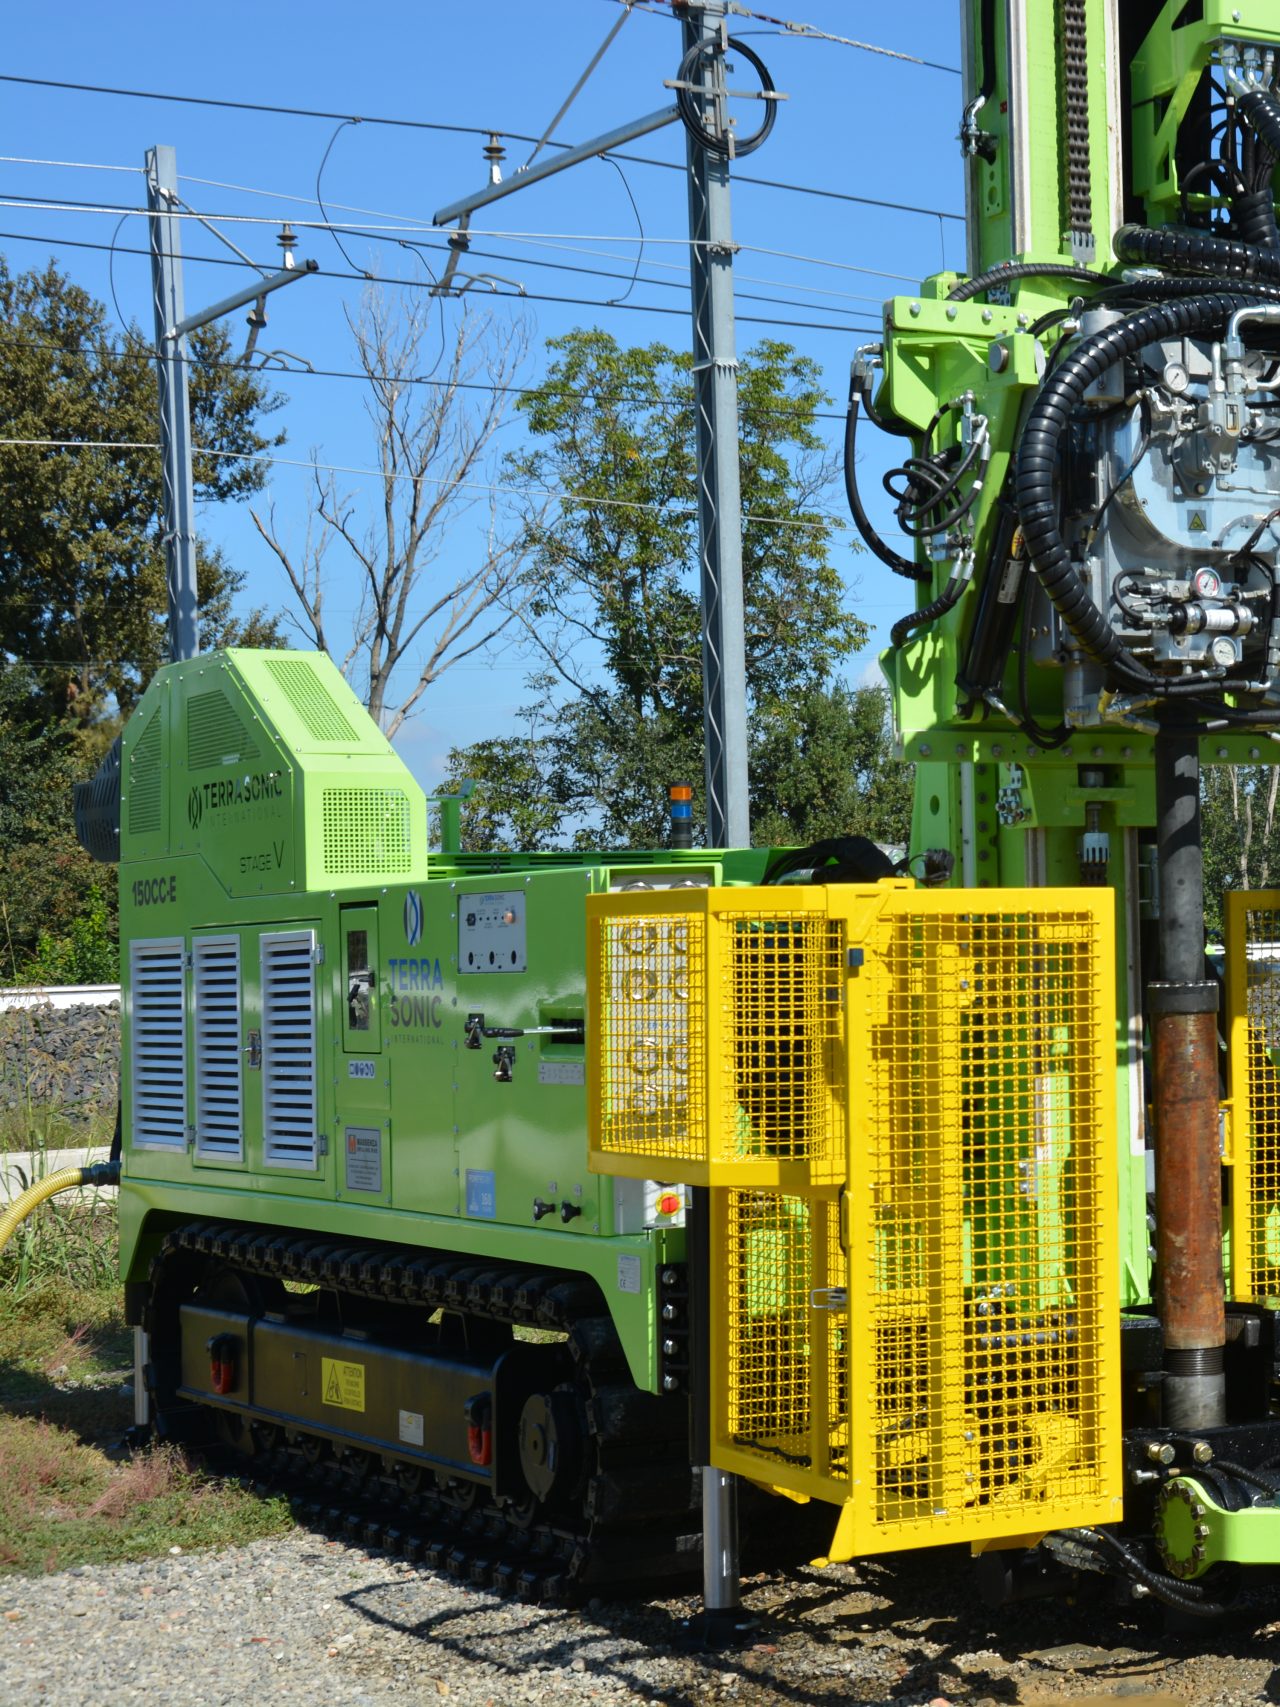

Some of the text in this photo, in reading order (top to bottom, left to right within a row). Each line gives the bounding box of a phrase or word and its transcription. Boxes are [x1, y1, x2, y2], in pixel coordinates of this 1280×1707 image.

[203, 770, 282, 809] TERRASONIC
[240, 840, 284, 873] STAGE V
[132, 876, 176, 907] 150CC-E
[388, 958, 444, 991] TERRA
[391, 995, 442, 1028] SONIC
